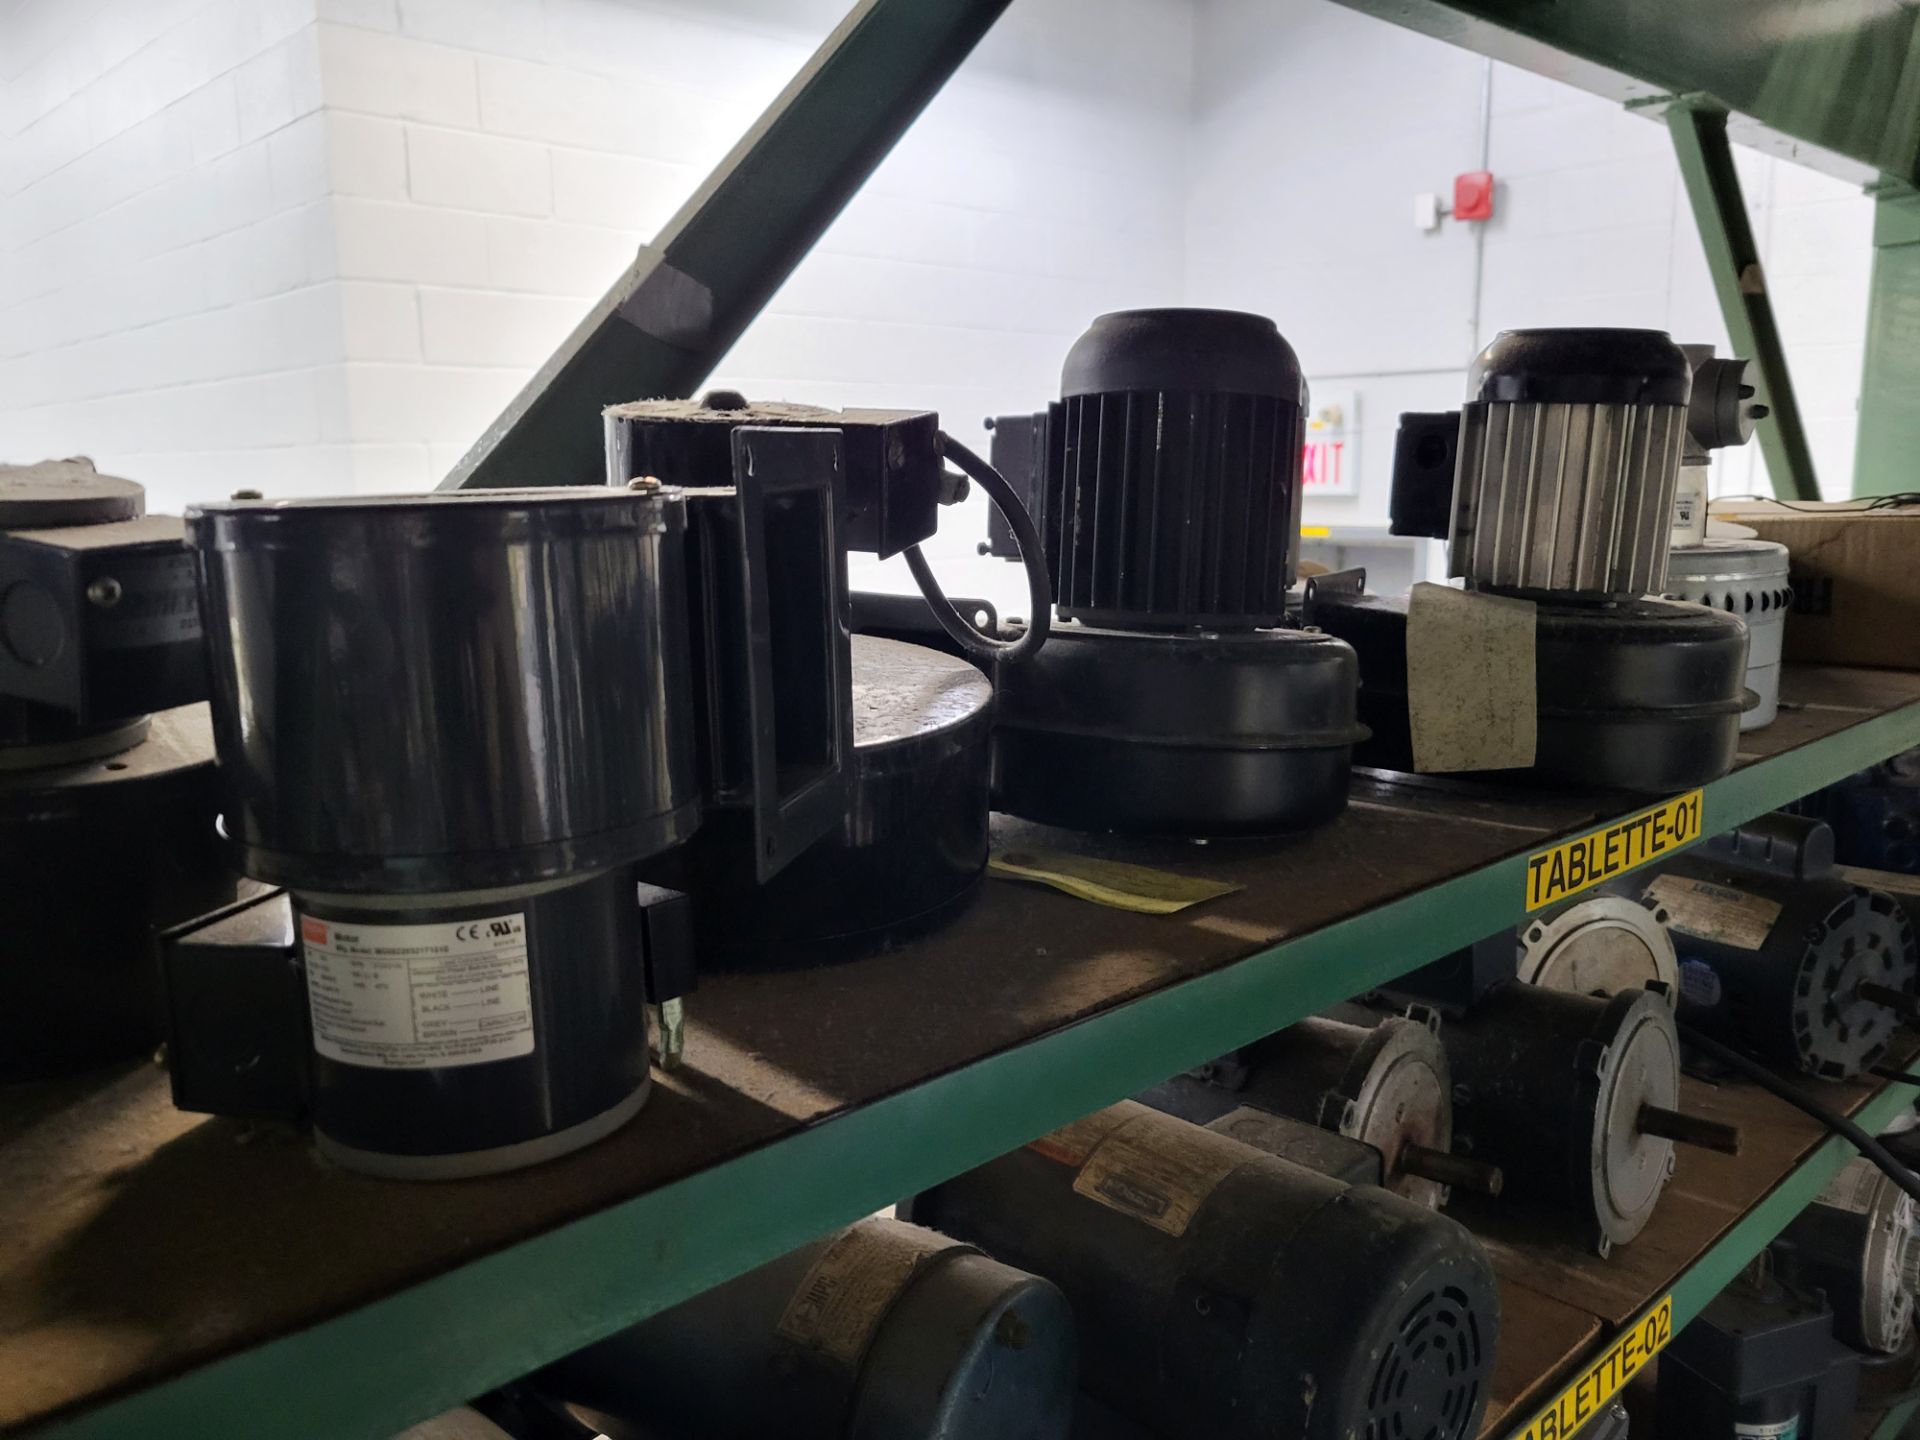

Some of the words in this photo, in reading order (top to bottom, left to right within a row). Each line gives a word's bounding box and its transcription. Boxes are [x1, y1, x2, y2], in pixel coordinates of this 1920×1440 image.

[1300, 442, 1344, 485] XIT
[1529, 796, 1698, 904] TABLETTE-01
[1524, 1303, 1669, 1440] BLETTE-02
